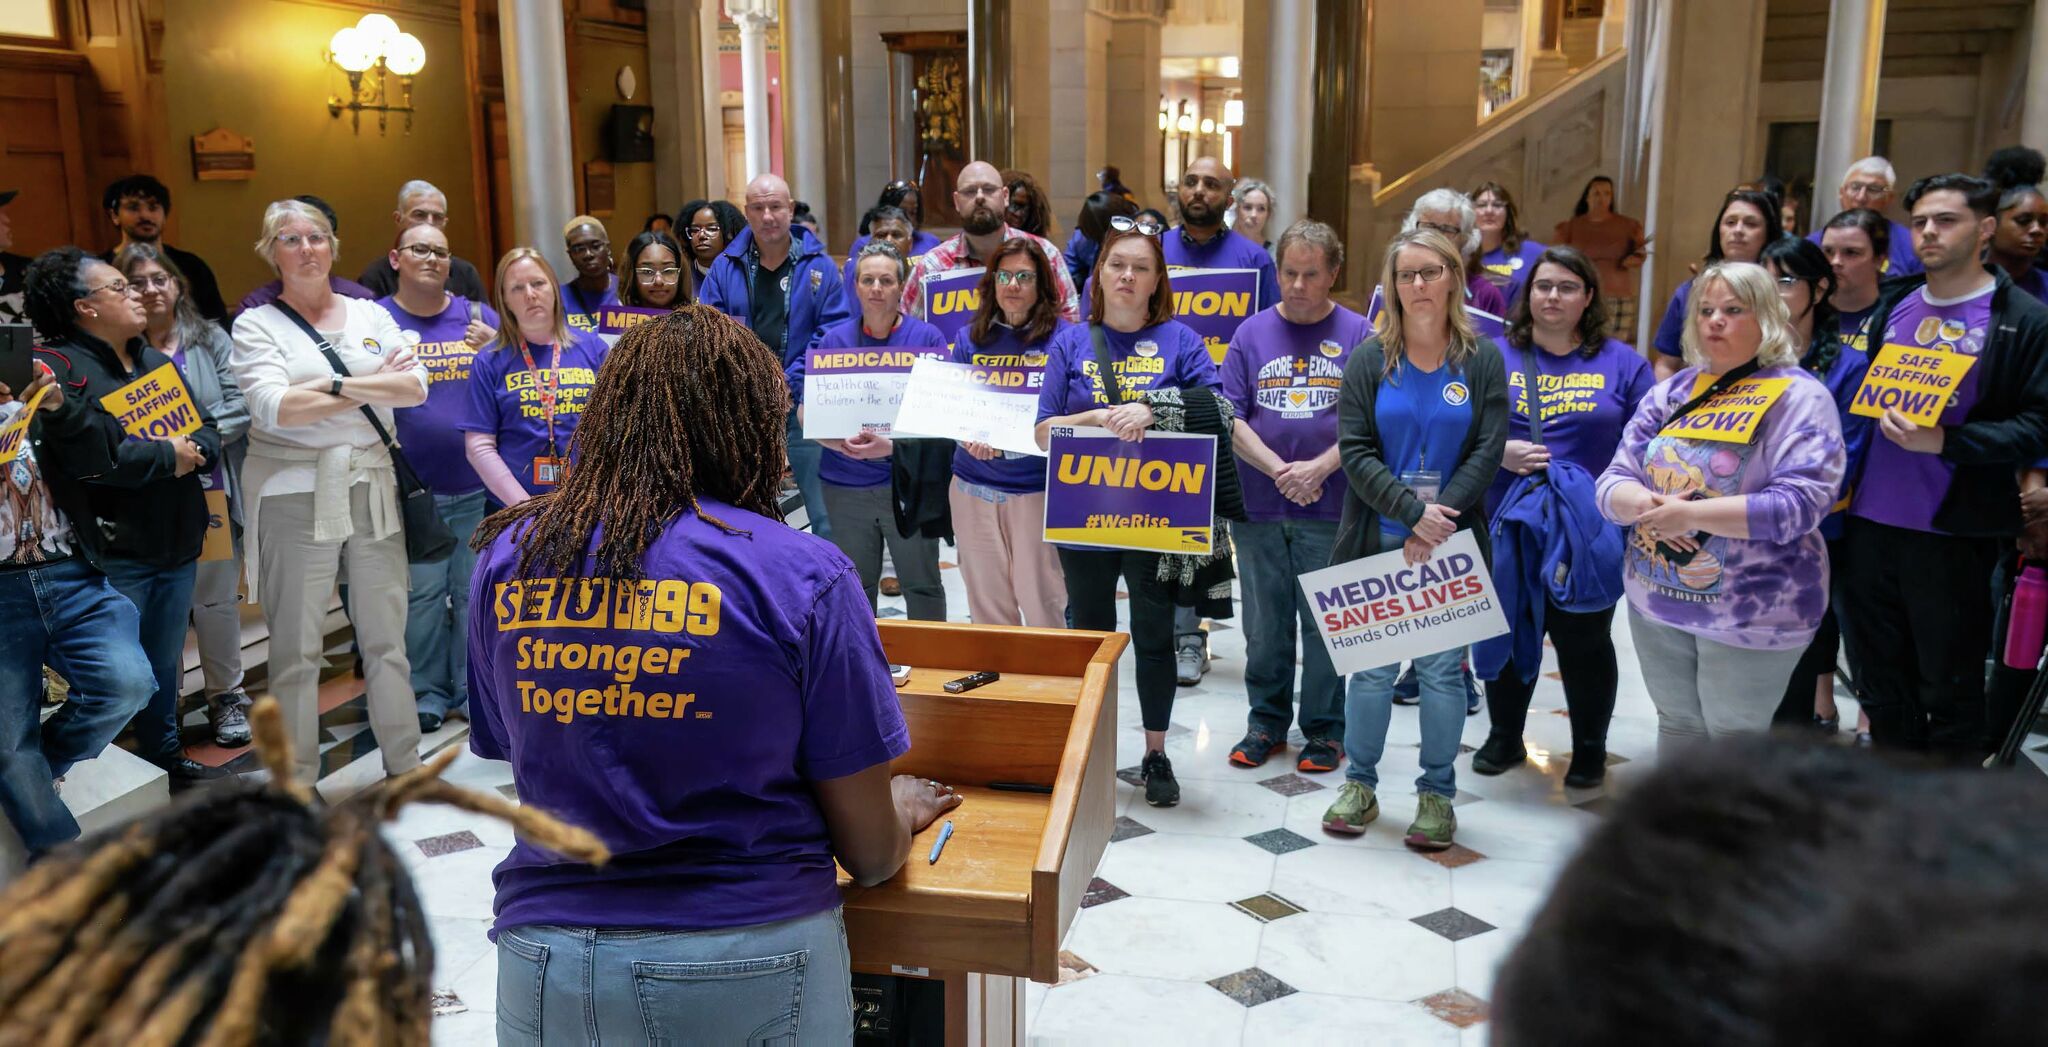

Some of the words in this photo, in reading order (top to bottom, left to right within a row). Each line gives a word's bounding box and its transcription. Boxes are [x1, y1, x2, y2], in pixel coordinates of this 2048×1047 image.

[1172, 291, 1251, 317] ION
[813, 352, 915, 369] MEDICAID
[1898, 353, 1943, 370] SAFE
[505, 369, 557, 392] SEU
[950, 368, 1025, 387] DICAID
[1871, 365, 1951, 388] STAFFING
[125, 379, 161, 405] SAFE
[1258, 390, 1287, 409] SAVE
[1700, 396, 1768, 409] TAFFING
[1857, 384, 1941, 417] NOW!
[118, 386, 181, 428] STAFFING
[1669, 411, 1755, 432] NOW!
[1057, 453, 1207, 495] UNION
[1085, 513, 1171, 529] #WeRise
[1314, 552, 1474, 613] MEDICAID
[494, 577, 608, 632] SEIU
[1324, 599, 1405, 632] SAVES
[1406, 575, 1484, 612] LIVES
[1330, 628, 1383, 650] Hands
[1385, 620, 1411, 637] Off
[1414, 597, 1492, 632] Medicaid
[516, 636, 691, 683] Stronger
[516, 682, 695, 725] Together
